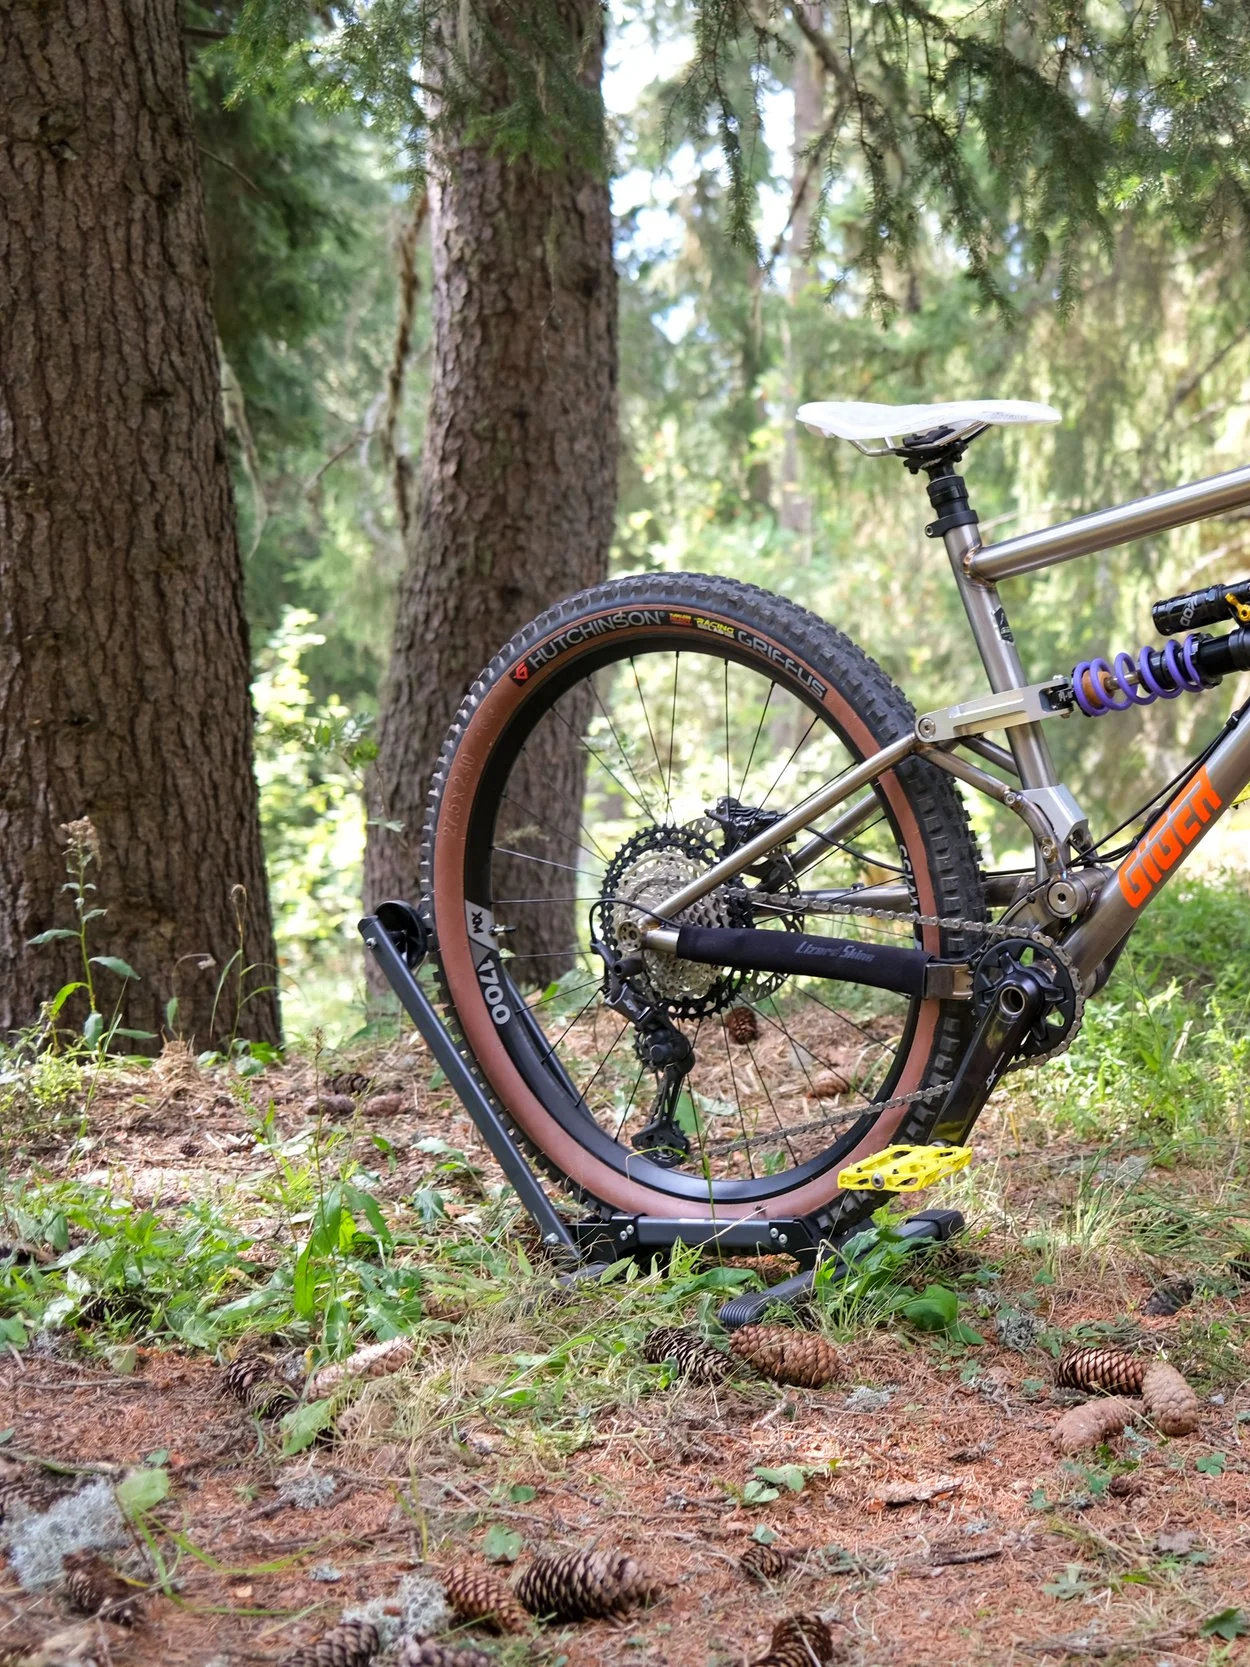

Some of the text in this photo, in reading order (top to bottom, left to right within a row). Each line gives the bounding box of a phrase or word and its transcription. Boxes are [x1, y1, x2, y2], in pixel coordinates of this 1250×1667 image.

[528, 611, 662, 669] HUTCHINSON
[695, 617, 735, 634] RACING
[737, 631, 825, 698] GRIFFUS
[840, 945, 876, 962] Skins
[478, 960, 511, 1024] 1700
